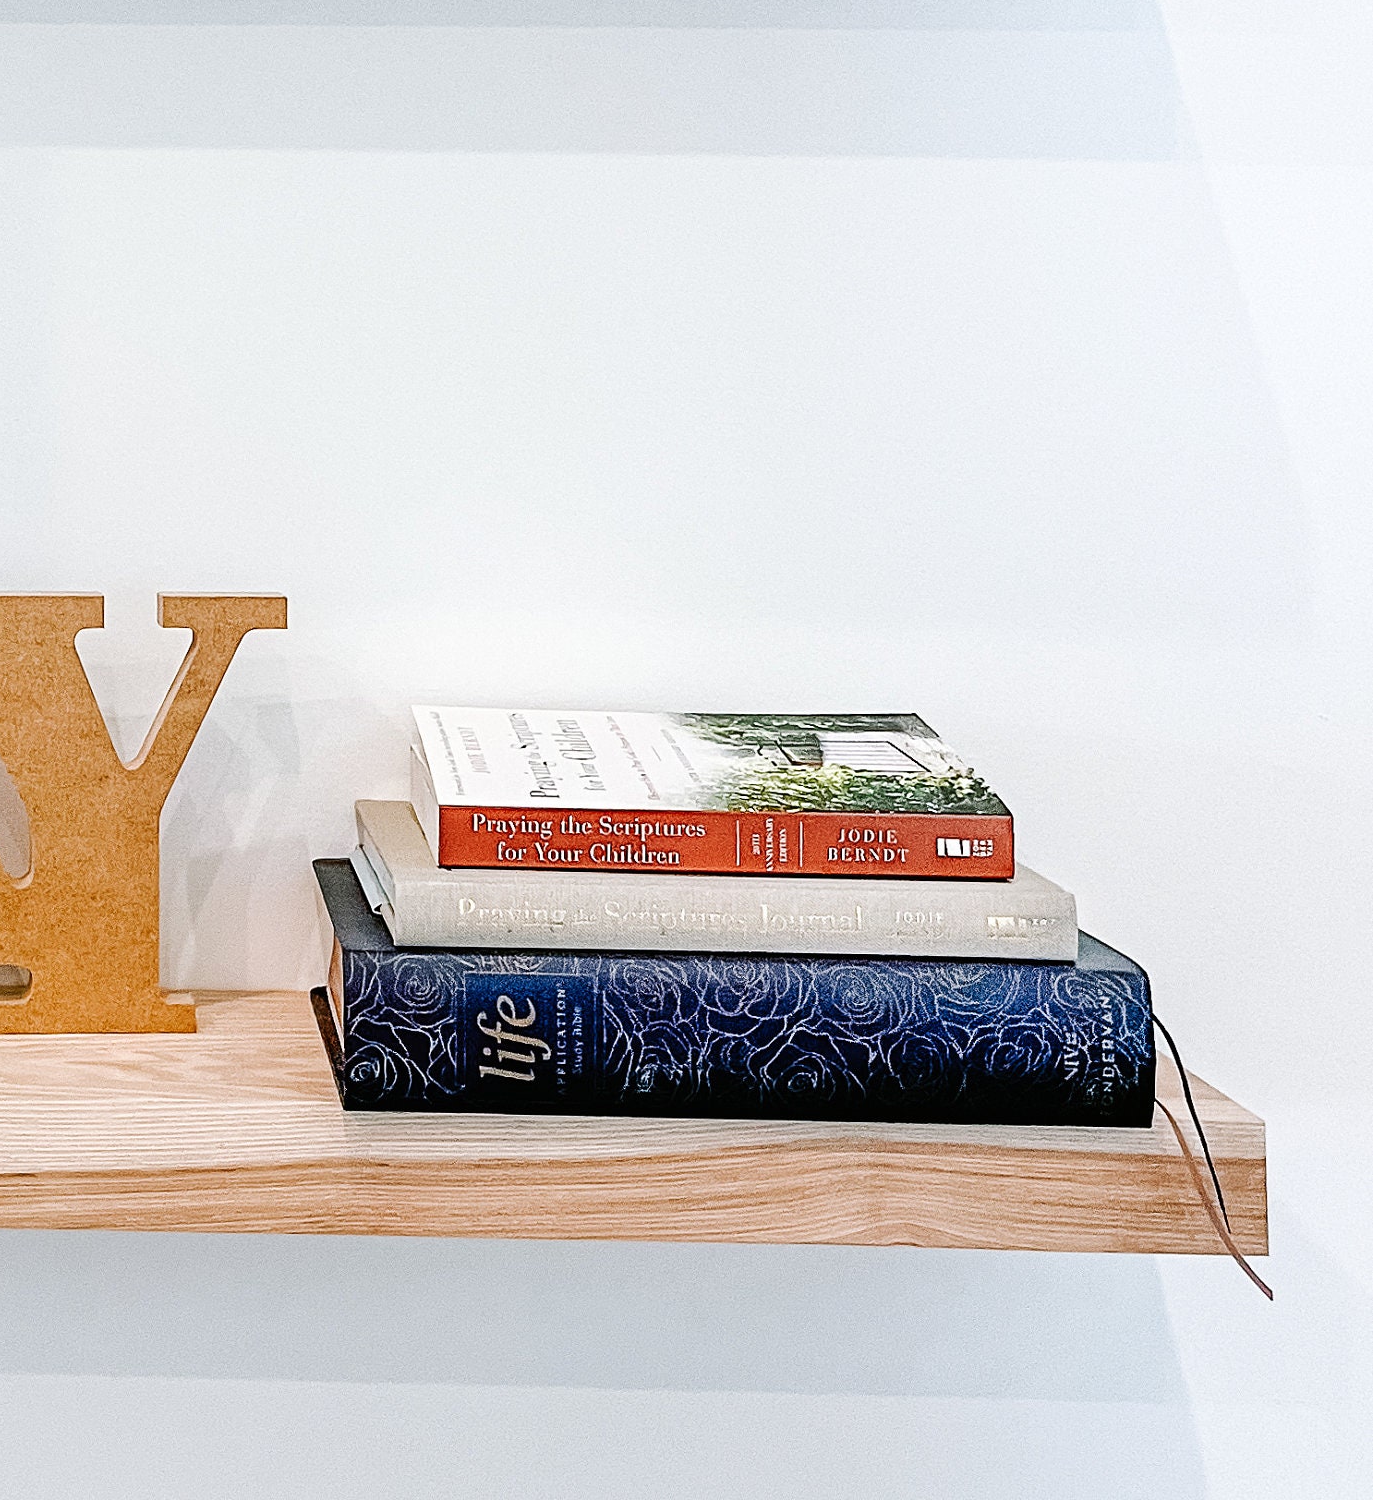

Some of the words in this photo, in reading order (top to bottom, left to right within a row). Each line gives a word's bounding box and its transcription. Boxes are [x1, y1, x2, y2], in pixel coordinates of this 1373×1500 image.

[471, 813, 554, 839] Praying
[559, 815, 593, 834] the
[598, 815, 707, 843] Scriptures
[837, 828, 899, 845] JODIE
[496, 841, 528, 862] for
[534, 842, 584, 863] Your
[589, 843, 680, 865] Children
[826, 846, 911, 864] BERNDT
[457, 898, 568, 931] Praying
[604, 901, 749, 936] Scriptures
[760, 904, 864, 933] Journal
[476, 994, 553, 1082] life
